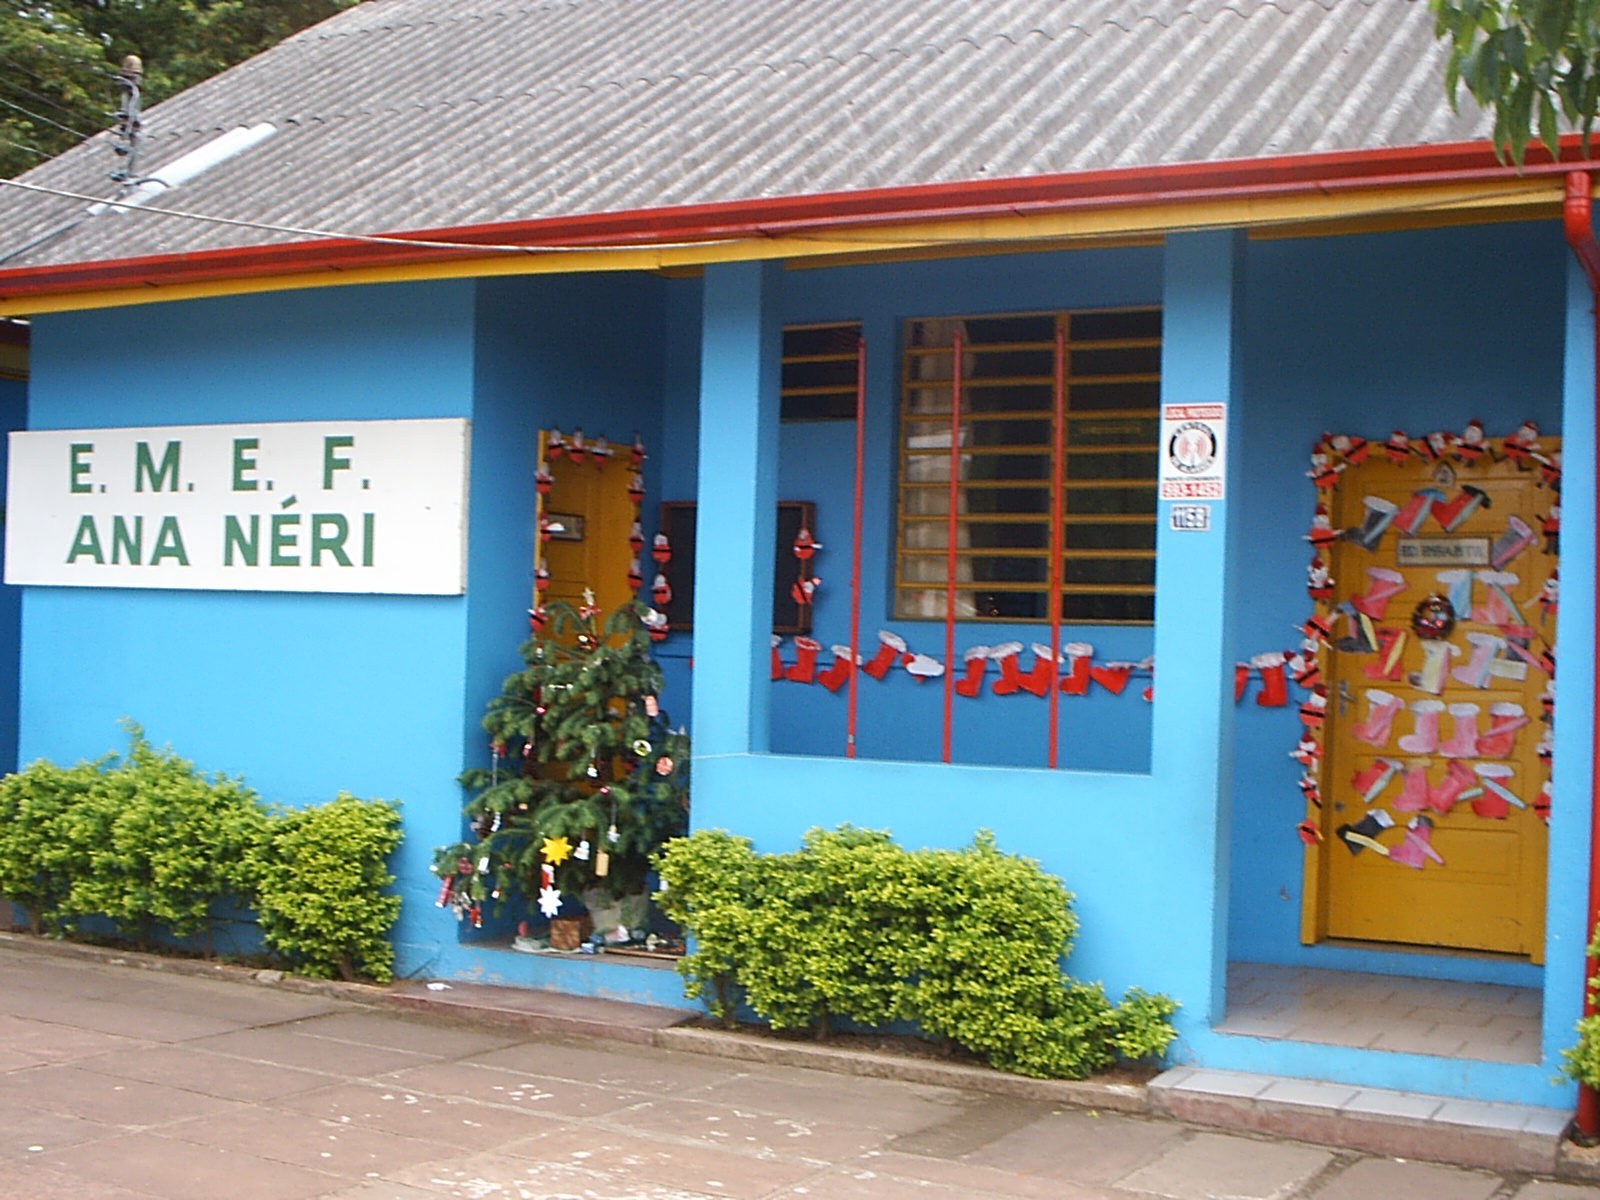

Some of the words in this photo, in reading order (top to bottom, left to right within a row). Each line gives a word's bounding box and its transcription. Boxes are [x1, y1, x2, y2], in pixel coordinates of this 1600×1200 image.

[69, 442, 107, 494] E.
[134, 440, 195, 493] M.
[232, 437, 274, 492] E.
[322, 435, 370, 490] F.
[65, 515, 190, 566] ANA
[223, 494, 375, 567] NÉRI
